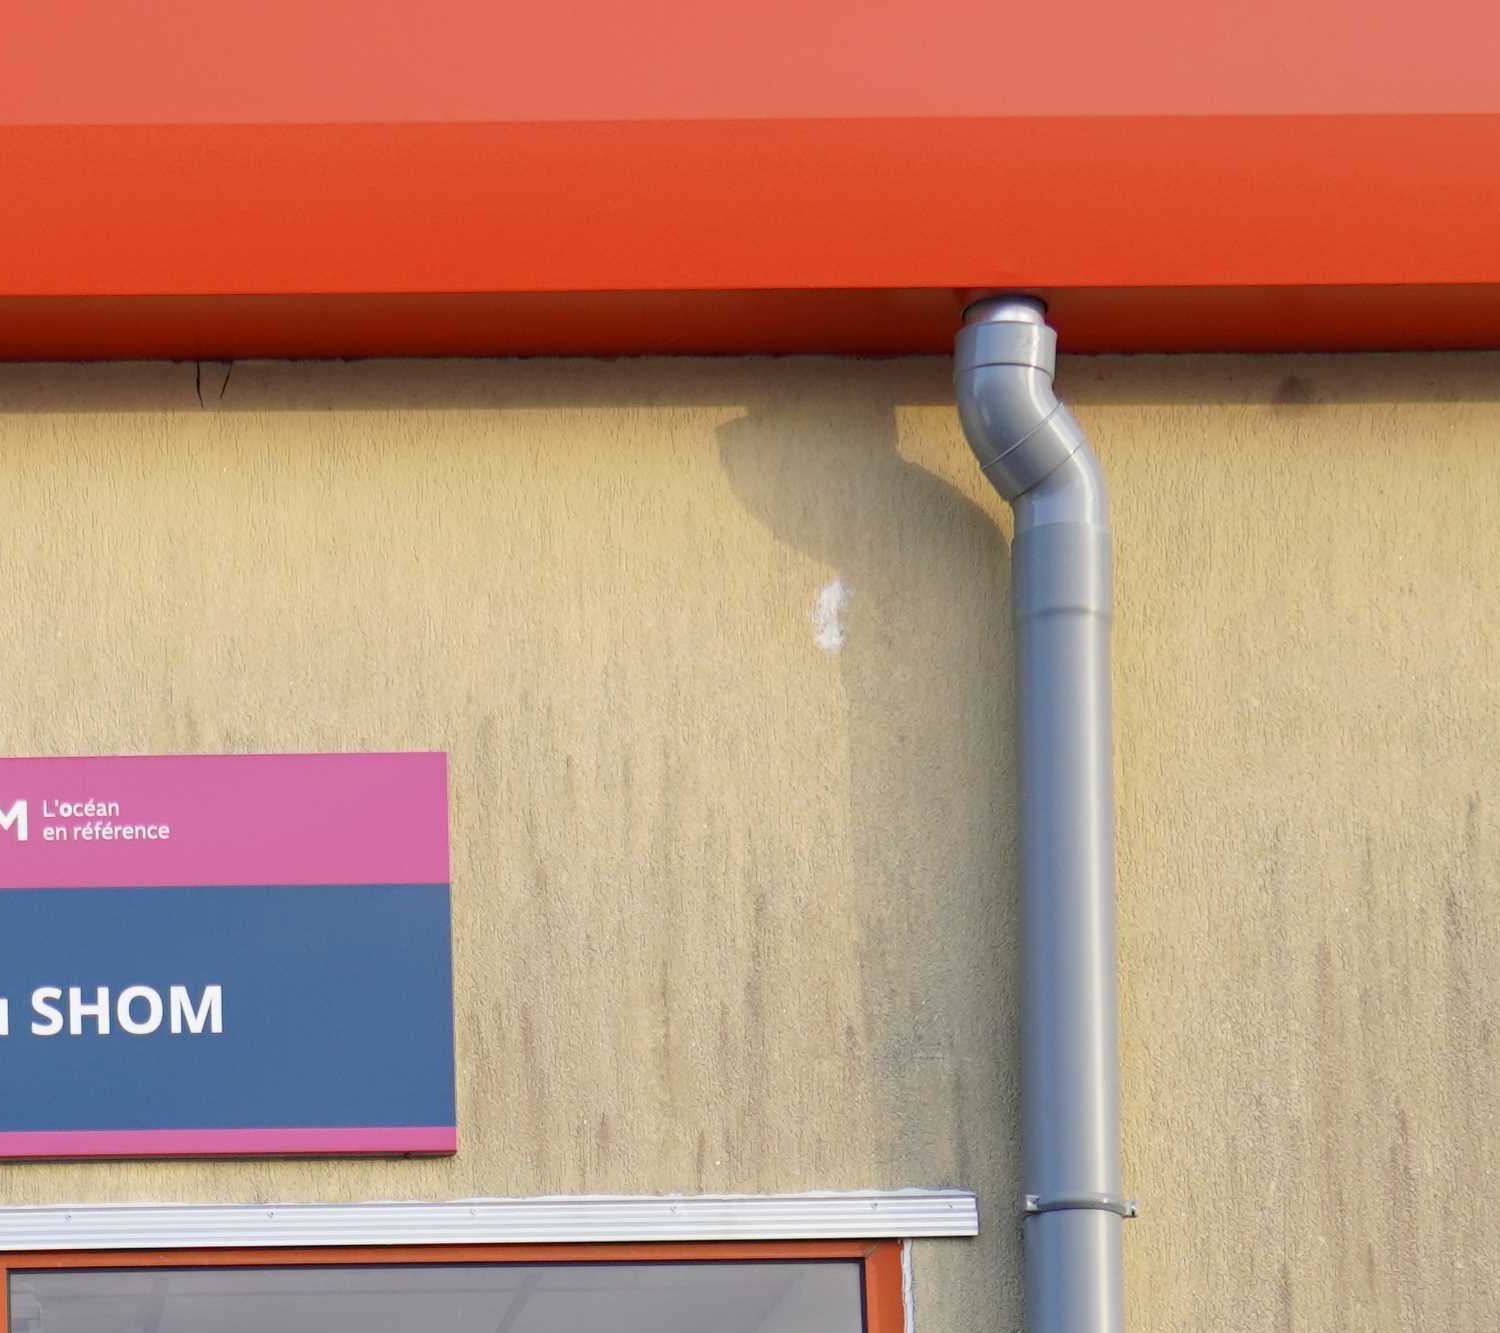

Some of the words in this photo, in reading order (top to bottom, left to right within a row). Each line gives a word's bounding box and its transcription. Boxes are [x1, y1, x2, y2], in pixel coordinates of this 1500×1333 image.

[42, 799, 120, 818] L'océan
[42, 826, 67, 841] en
[73, 820, 170, 841] référence
[31, 985, 223, 1036] SHOM
